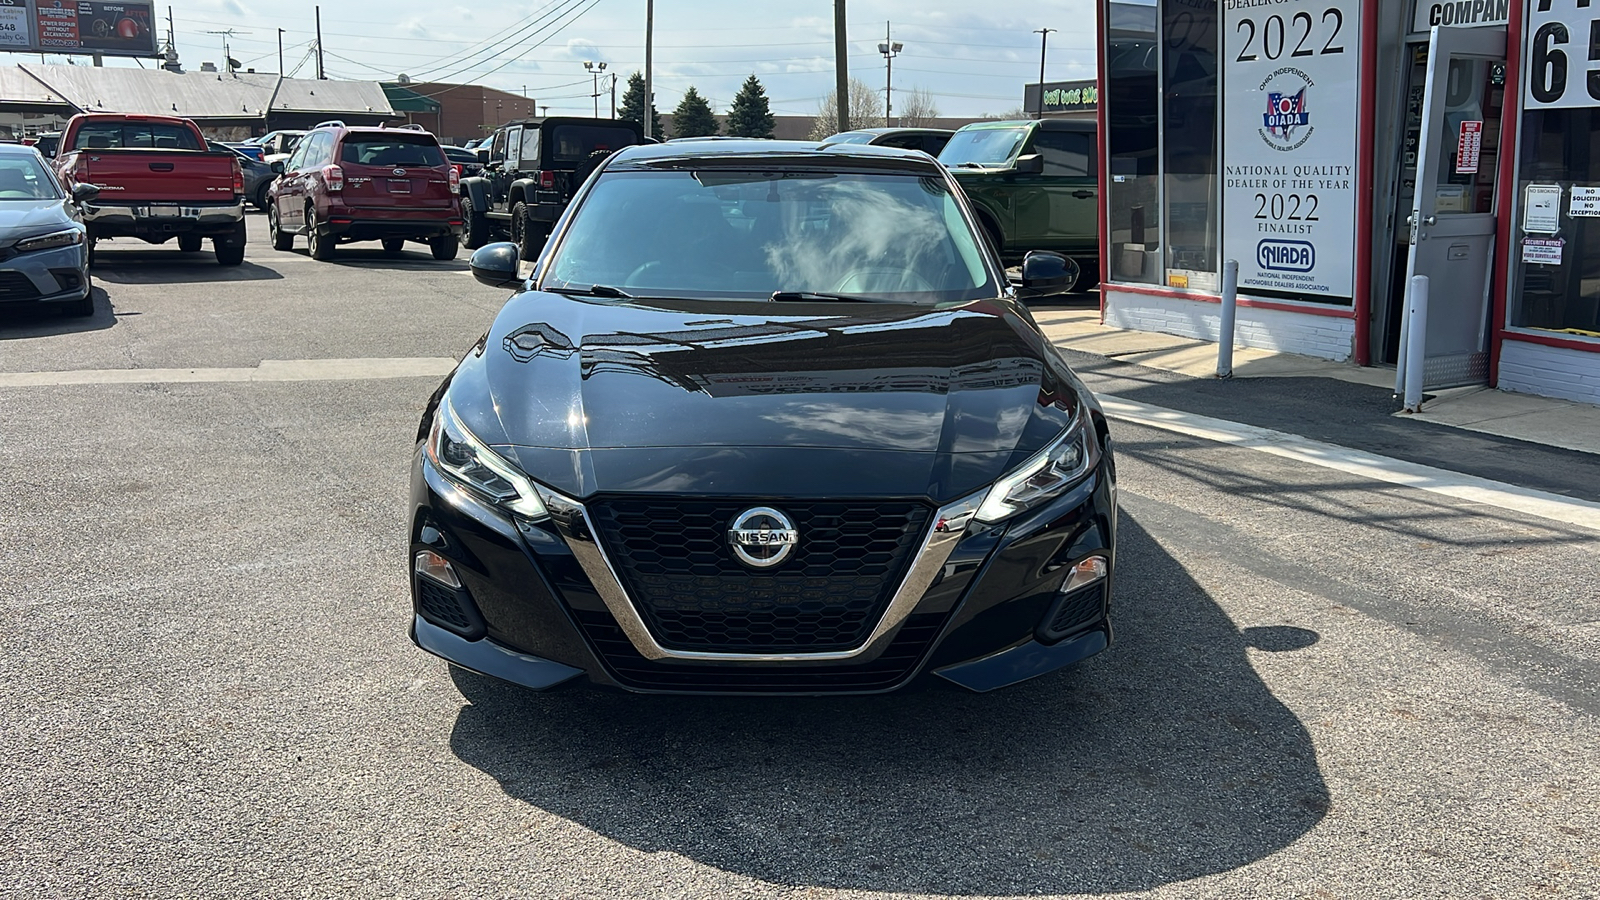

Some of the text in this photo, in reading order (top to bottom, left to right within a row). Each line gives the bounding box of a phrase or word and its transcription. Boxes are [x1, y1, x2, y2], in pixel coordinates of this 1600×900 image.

[1236, 8, 1344, 62] 2022
[1259, 67, 1315, 91] OHIO INDEPENDENT
[1268, 114, 1301, 126] OIADA
[1258, 128, 1277, 150] AUTOMOBILE
[1293, 126, 1315, 150] ASSOCIATION
[1226, 165, 1352, 177] NATIONAL QUALITY
[1227, 179, 1350, 190] DEALER OF THE YEAR
[1254, 193, 1319, 221] 2022
[1258, 223, 1313, 234] FINALIST
[1262, 246, 1310, 267] NIADA
[1257, 272, 1315, 282] NATIONAL INDEPENDENT
[1244, 279, 1330, 292] AUTOMOBILE DEALERS ASSOCIATION
[736, 532, 789, 542] NISSAN
